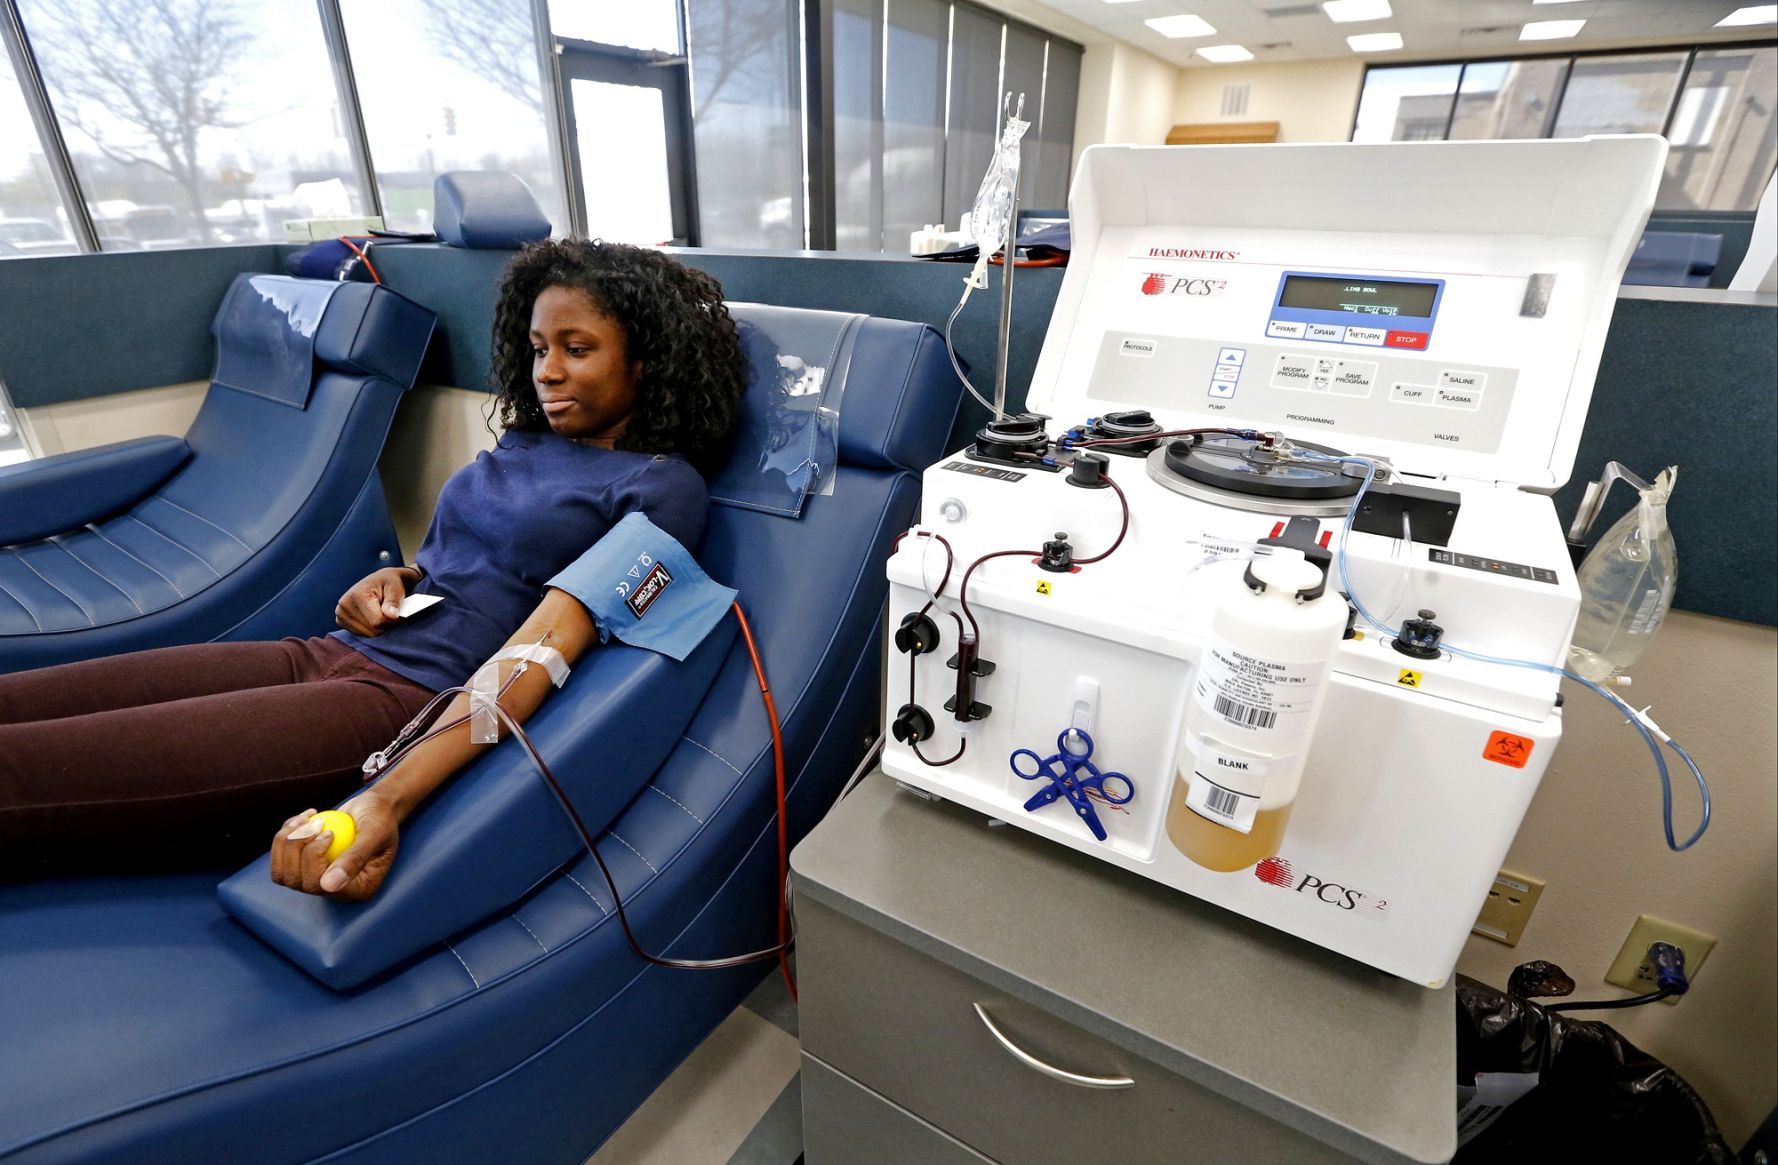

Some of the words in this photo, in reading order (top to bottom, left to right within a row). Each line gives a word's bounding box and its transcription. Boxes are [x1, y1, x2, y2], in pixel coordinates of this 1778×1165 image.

[1171, 277, 1218, 296] PCS
[1275, 325, 1298, 333] PRIME
[1314, 328, 1336, 336] DRAW
[1349, 332, 1381, 341] RETURN
[1395, 335, 1418, 344] STOP
[1123, 344, 1153, 352] PROTOCOLS
[1282, 366, 1307, 374] MODIFY
[1277, 370, 1310, 380] PROGRAM
[1335, 377, 1369, 386] PROGRAM
[1449, 377, 1475, 385] SALINE
[1442, 394, 1472, 403] PLASMA
[1286, 414, 1335, 425] PROGRAMMING
[1434, 433, 1459, 442] VALVES
[1232, 651, 1256, 665] SOURCE
[1259, 661, 1286, 671] PLASMA
[1220, 657, 1273, 680] MANUFACTURING
[1240, 661, 1269, 673] CAUTION
[1217, 757, 1249, 770] BLANK
[1296, 873, 1363, 910] PCS
[1376, 900, 1388, 910] 2
